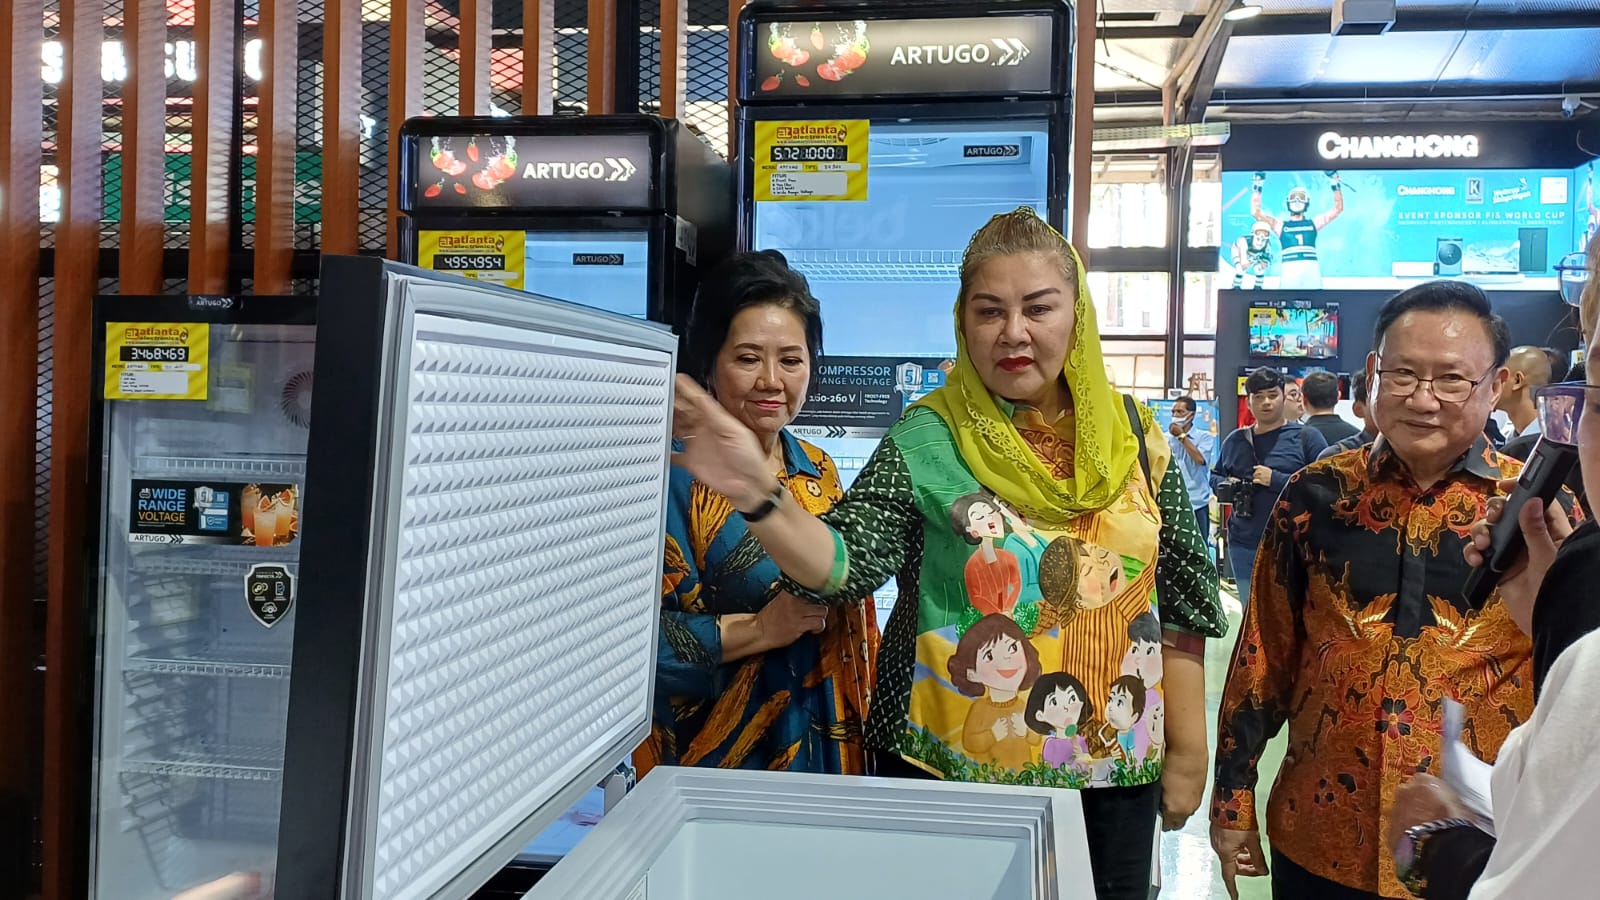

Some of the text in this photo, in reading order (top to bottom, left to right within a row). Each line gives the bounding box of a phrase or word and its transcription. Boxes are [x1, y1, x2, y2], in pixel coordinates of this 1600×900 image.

[890, 44, 990, 66] ARTUGO
[793, 125, 837, 135] atlanta
[1317, 131, 1479, 160] CHANGHONG
[966, 147, 1003, 157] ARTUGO
[523, 162, 605, 179] ARTUGO
[1398, 211, 1430, 219] EVENT
[1434, 211, 1481, 219] SPONSOR
[1505, 211, 1541, 219] WORLD
[1545, 211, 1565, 219] CUP
[454, 235, 495, 244] atlanta
[575, 255, 609, 264] ARTUGO
[139, 327, 180, 336] atlanta
[818, 365, 891, 377] OMPRESSOR
[850, 377, 892, 386] VOLTAGE
[904, 369, 914, 385] 5
[152, 488, 186, 500] WIDE
[138, 500, 186, 512] RANGE
[138, 511, 186, 523] VOLTAGE
[134, 534, 166, 543] ARTUGO
